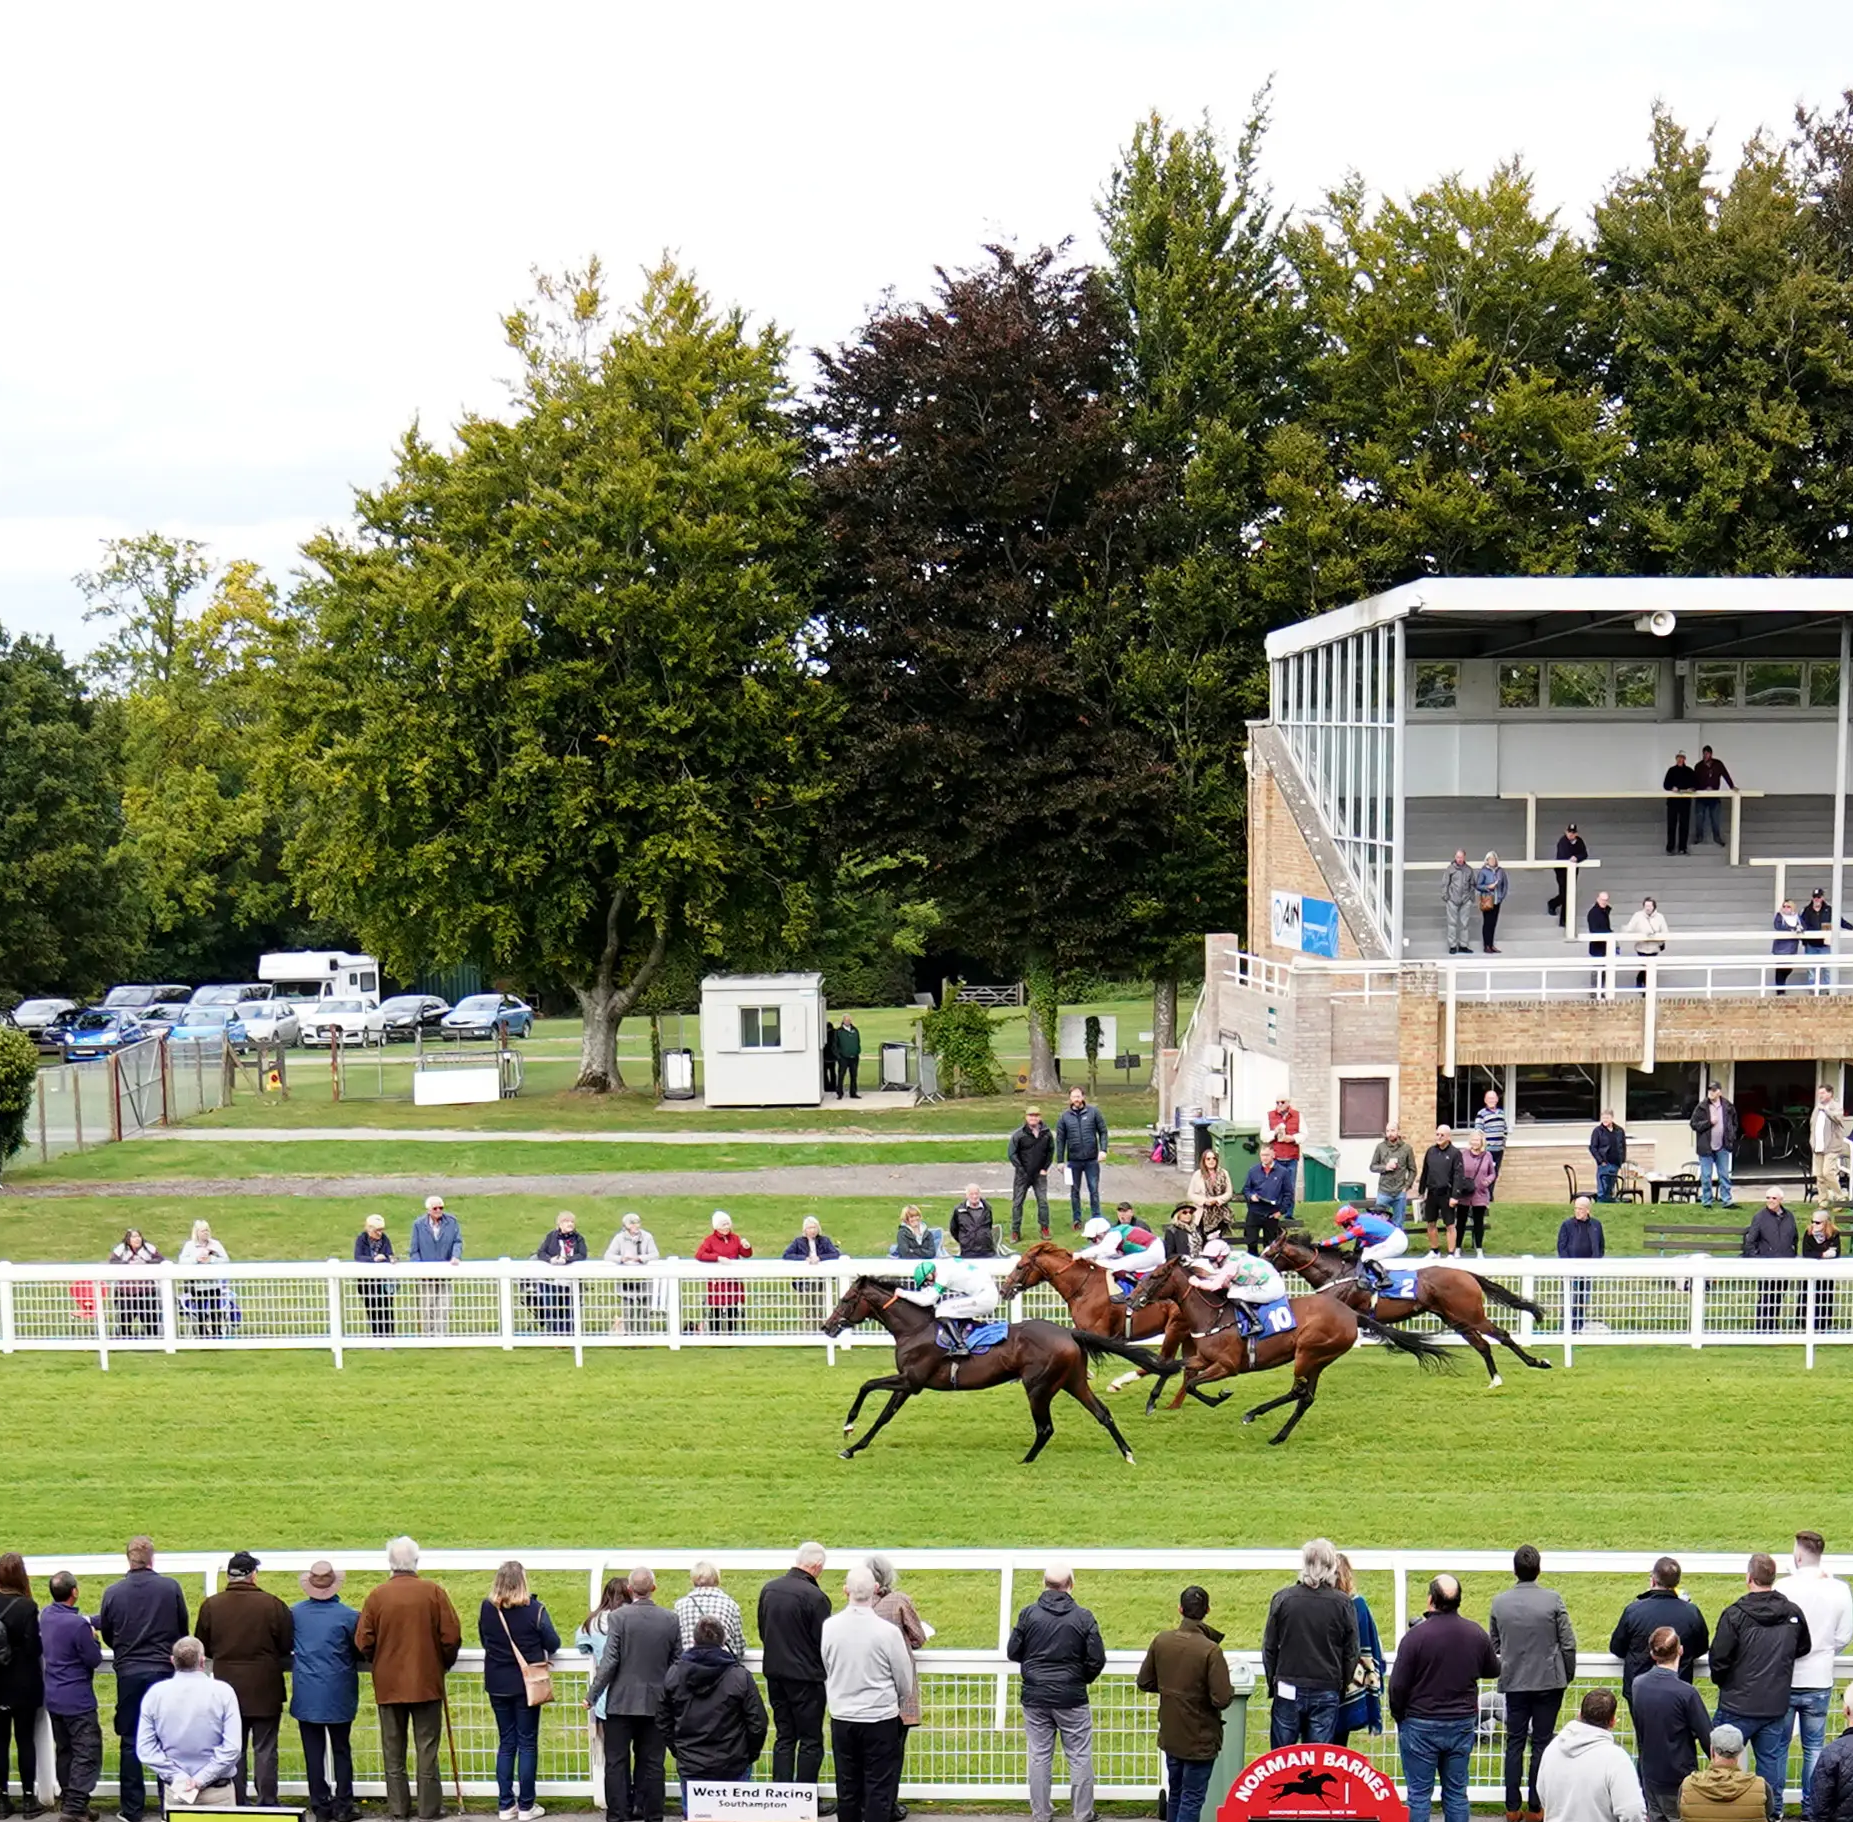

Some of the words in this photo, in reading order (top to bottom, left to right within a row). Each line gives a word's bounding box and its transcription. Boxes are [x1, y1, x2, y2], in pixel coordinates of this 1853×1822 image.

[1400, 1278, 1415, 1297] 2
[1268, 1306, 1293, 1332] 10
[1234, 1751, 1316, 1803] NORMAN
[1323, 1752, 1391, 1801] BARNES
[693, 1787, 727, 1797] West
[733, 1788, 760, 1798] End
[766, 1788, 813, 1801] Racing
[718, 1799, 788, 1809] Southampton
